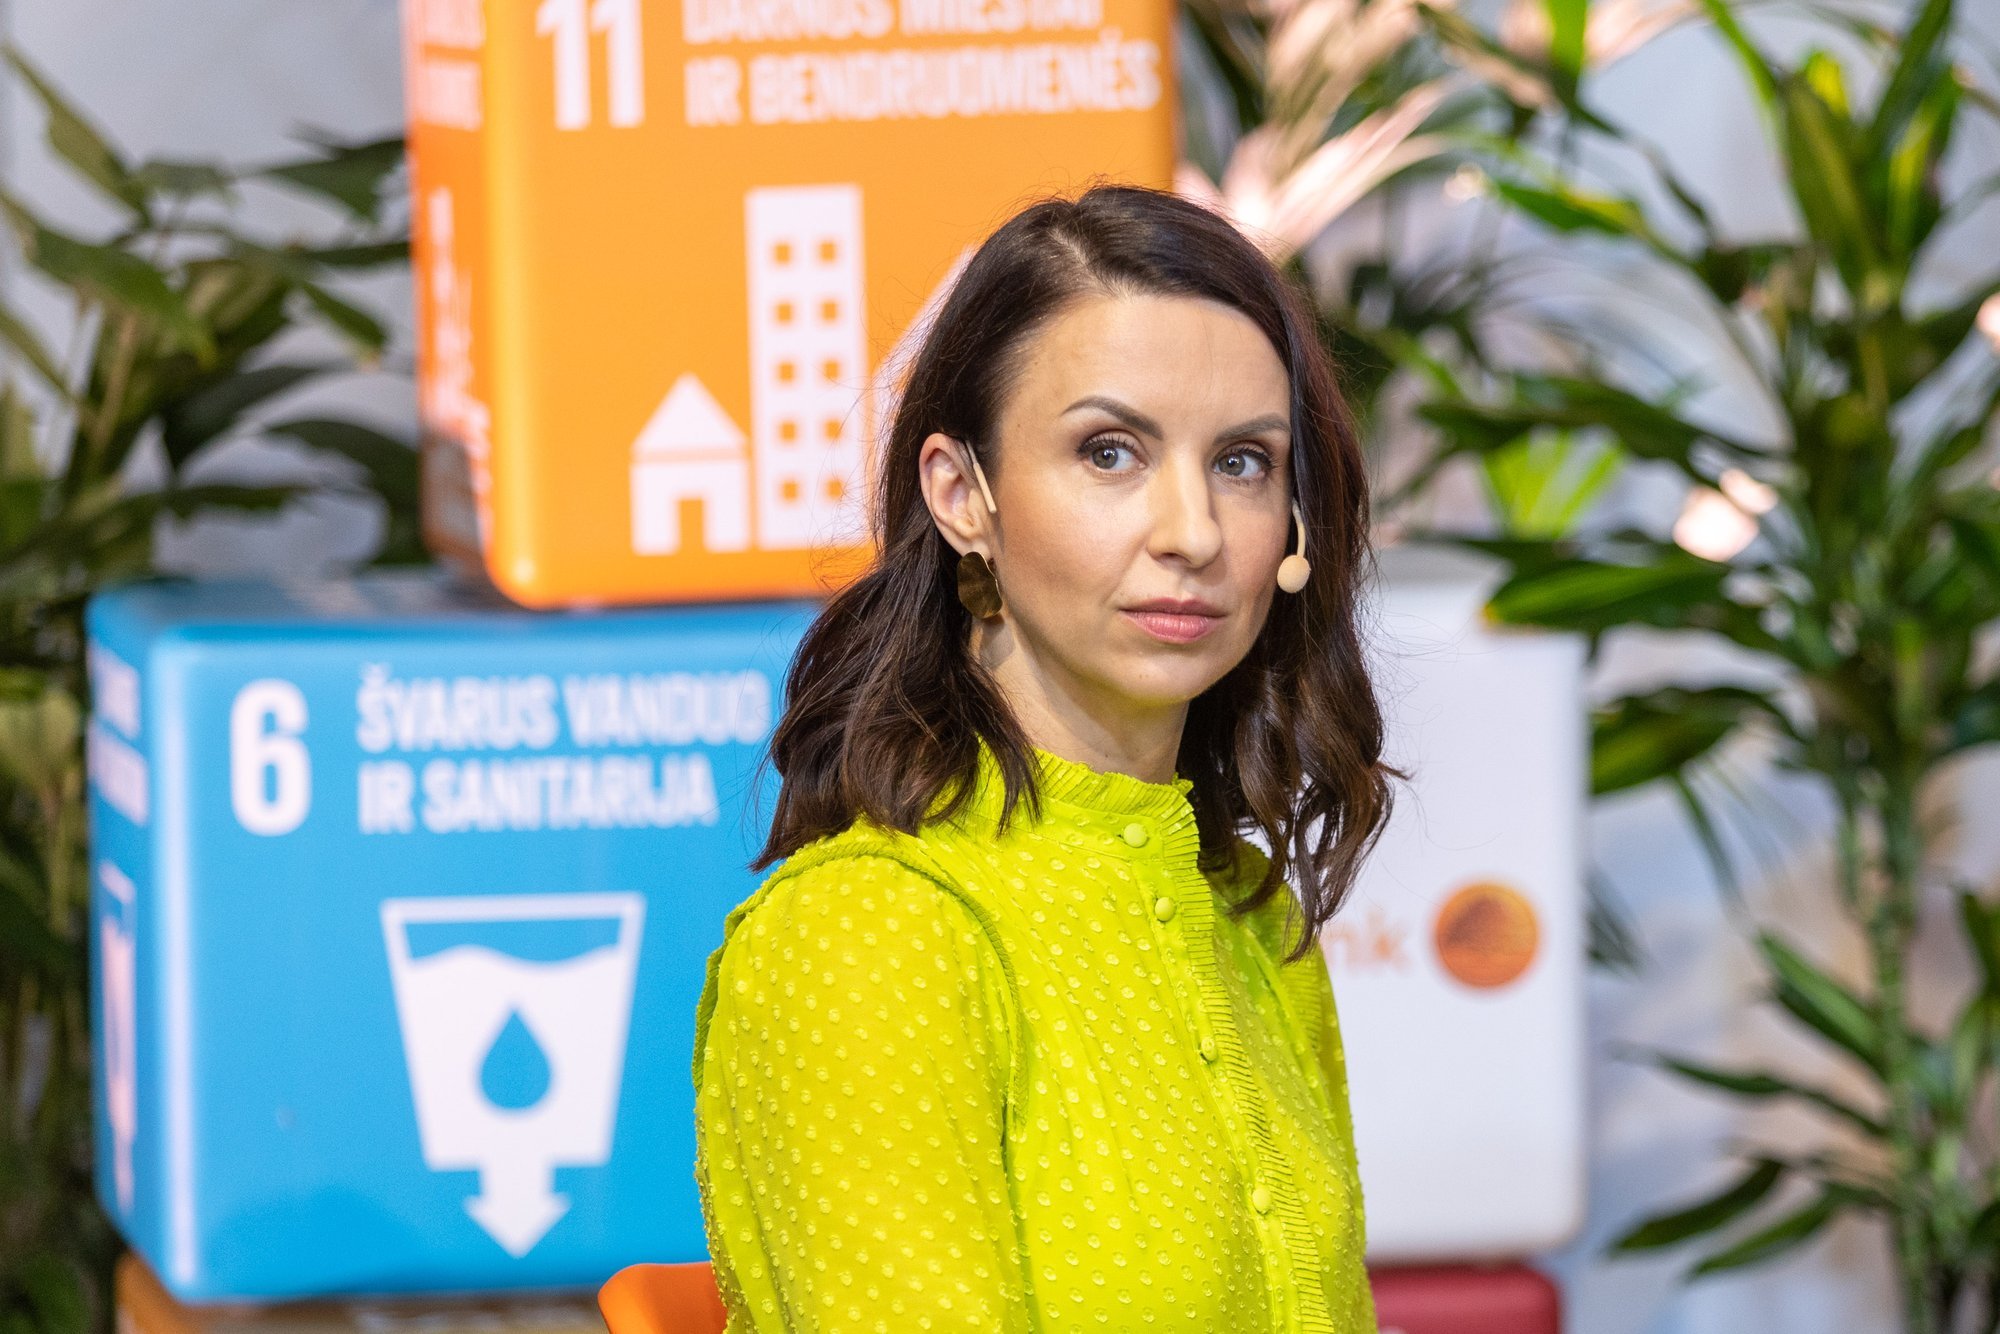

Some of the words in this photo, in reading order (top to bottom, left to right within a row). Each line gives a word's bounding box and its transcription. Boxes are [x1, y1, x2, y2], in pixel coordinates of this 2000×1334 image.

[536, 0, 645, 130] 11
[685, 57, 742, 126] IR
[357, 663, 559, 752] ŠVARUS
[563, 669, 771, 746] VANDUO
[230, 679, 311, 836] 6
[358, 760, 415, 834] IR
[422, 753, 719, 834] SANITARIJA
